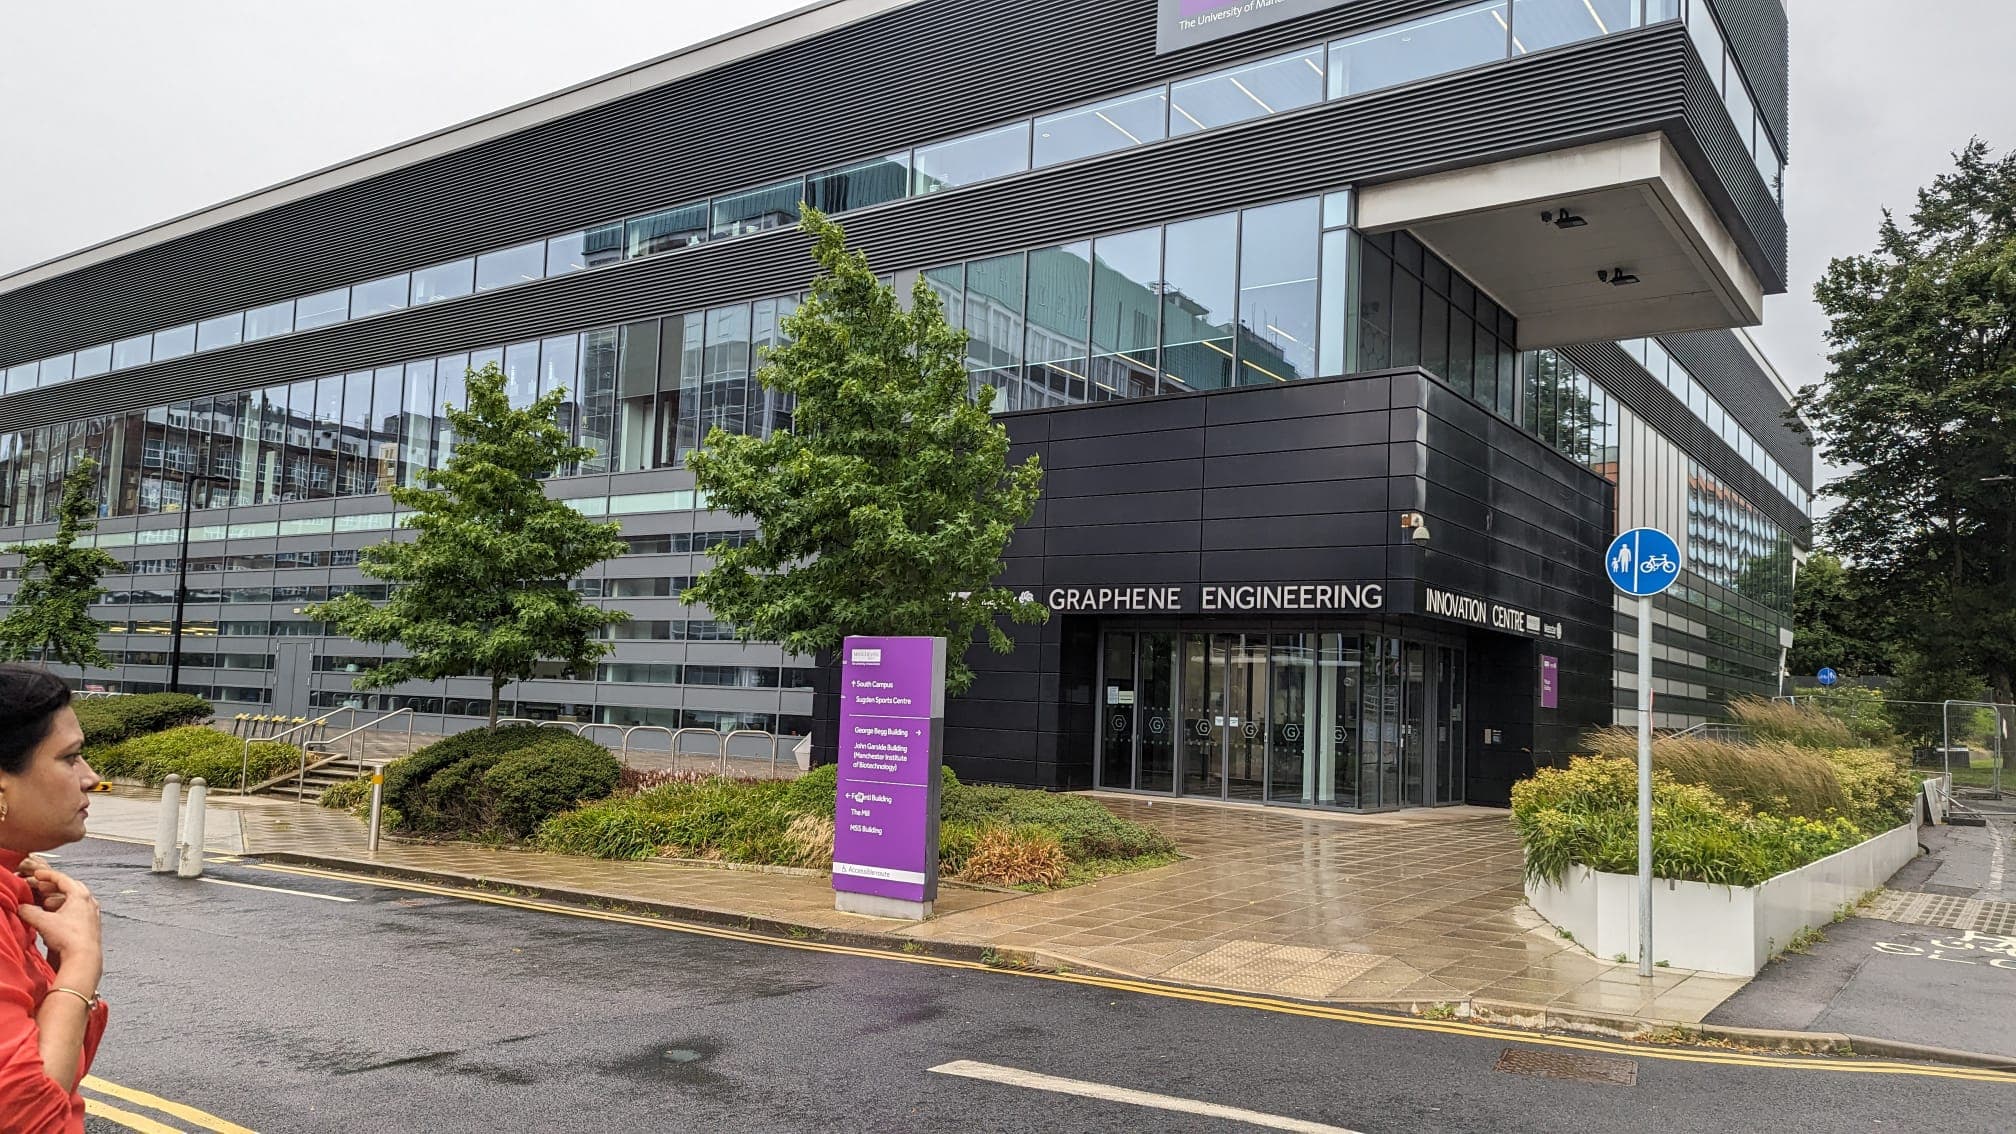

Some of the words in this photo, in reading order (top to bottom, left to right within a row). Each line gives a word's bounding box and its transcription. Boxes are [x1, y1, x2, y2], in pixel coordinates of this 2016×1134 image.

[1179, 19, 1196, 30] The
[1197, 6, 1242, 26] University
[1244, 2, 1255, 13] of
[1049, 587, 1181, 610] GRAPHENE
[1201, 584, 1383, 609] ENGINEERING
[1426, 587, 1487, 624] INNOVATION
[1492, 604, 1526, 632] CENTRE
[856, 680, 871, 688] South
[872, 680, 893, 690] Campus
[875, 696, 892, 704] Sports
[892, 697, 911, 705] Centre
[854, 727, 873, 736] George
[888, 728, 908, 737] Building
[886, 744, 908, 753] Building
[854, 751, 884, 760] (Manchester
[859, 762, 897, 772] Biotechnology)
[872, 794, 892, 804] Building
[851, 808, 861, 816] The
[862, 825, 882, 835] Building
